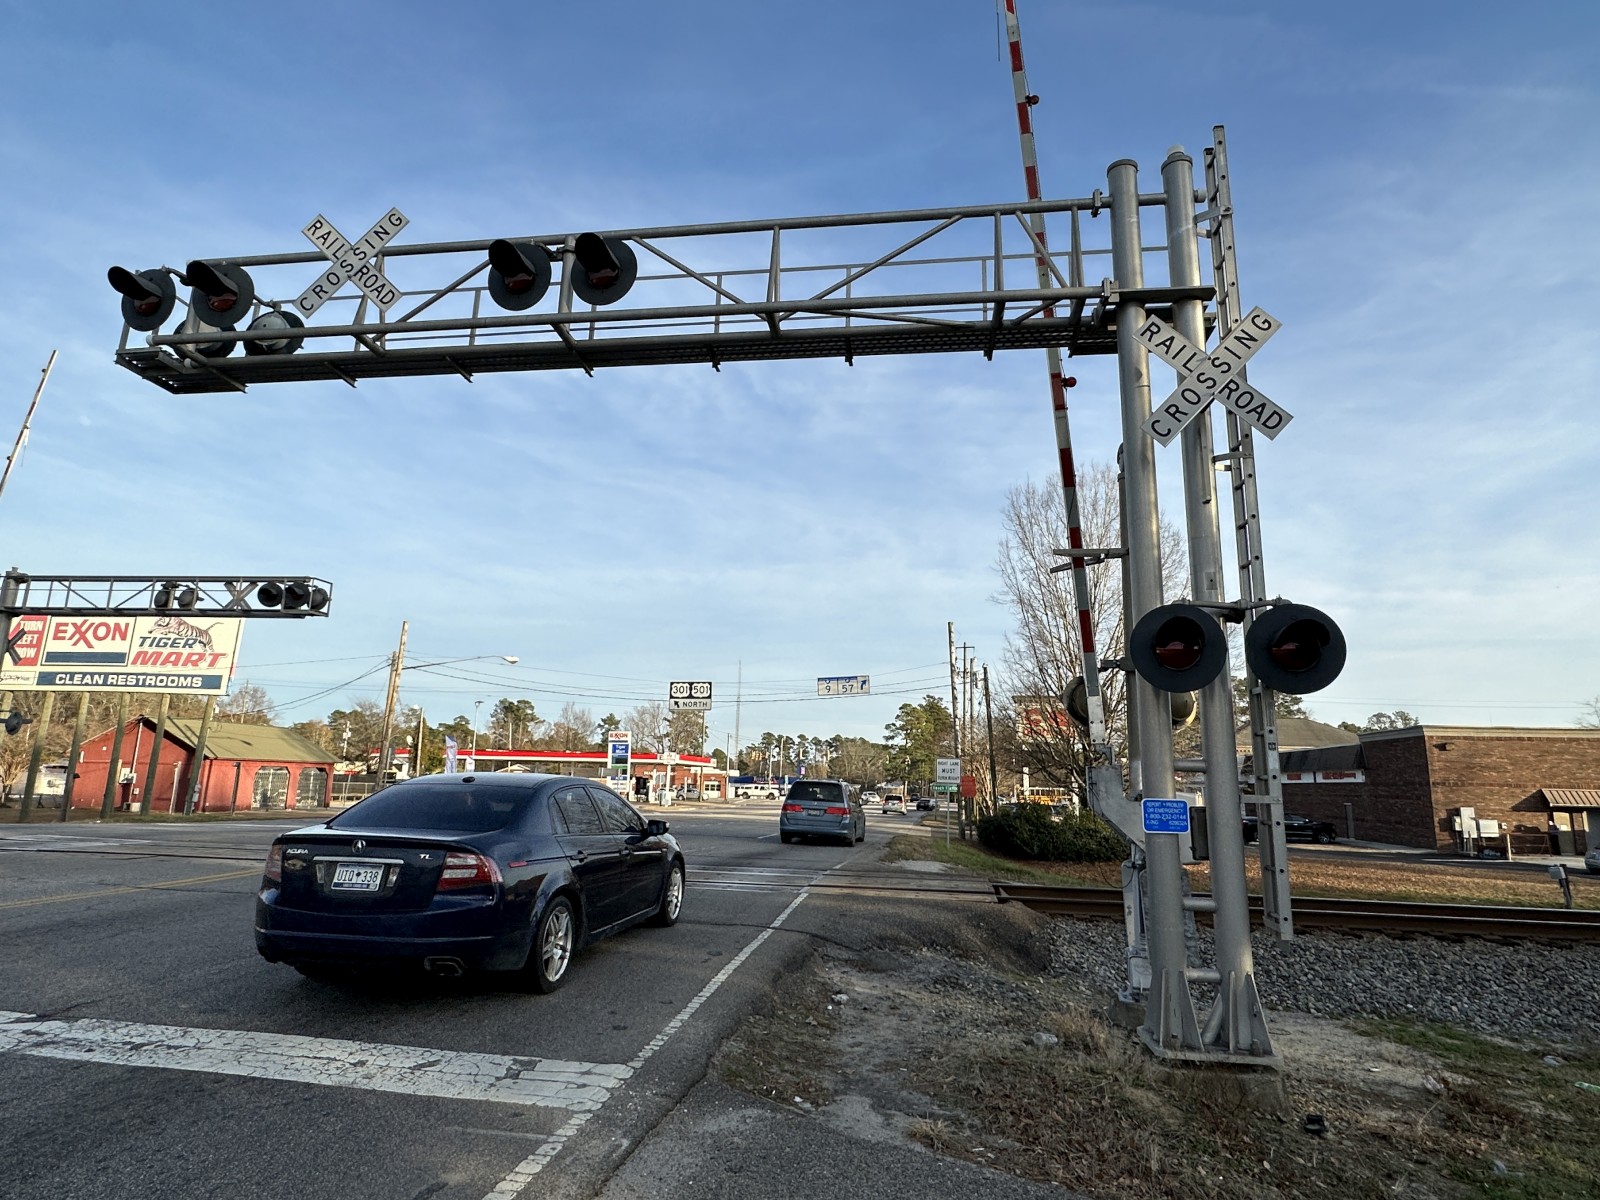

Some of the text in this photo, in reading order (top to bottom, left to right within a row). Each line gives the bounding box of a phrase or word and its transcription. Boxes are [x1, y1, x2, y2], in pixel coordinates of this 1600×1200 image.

[307, 219, 346, 261] RAIL
[299, 213, 403, 312] CROSSING
[353, 264, 396, 305] ROAD
[1140, 321, 1198, 373] RAIL
[1150, 314, 1273, 437] CROSSING
[1218, 378, 1284, 430] ROAD
[20, 620, 44, 631] TURN
[52, 619, 130, 649] EXXON
[138, 636, 198, 649] TIGER
[131, 650, 228, 668] MART
[55, 673, 203, 687] CLEAN RESTROOMS
[673, 685, 709, 694] 301 501
[825, 684, 854, 693] 9 57
[361, 871, 379, 883] 338
